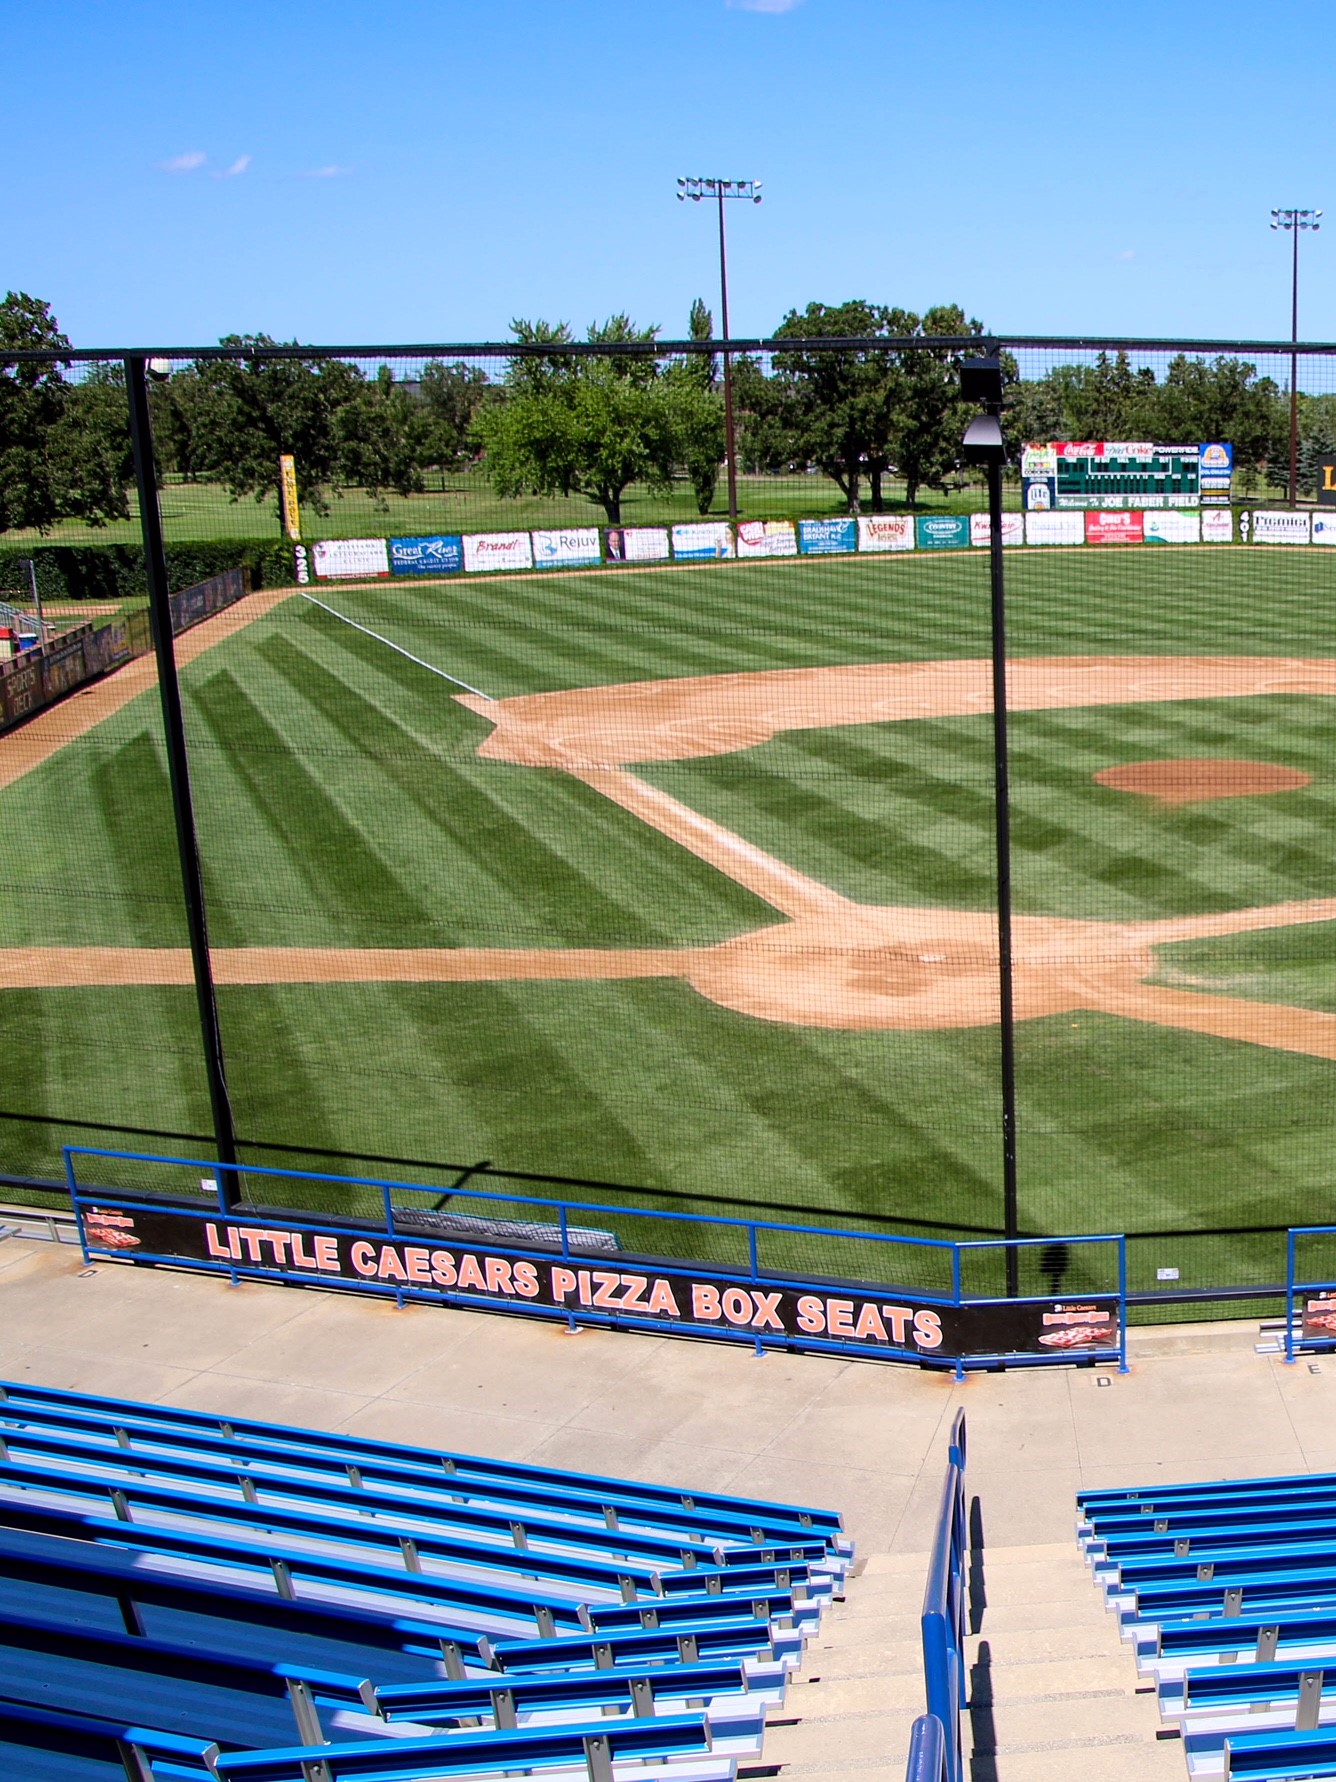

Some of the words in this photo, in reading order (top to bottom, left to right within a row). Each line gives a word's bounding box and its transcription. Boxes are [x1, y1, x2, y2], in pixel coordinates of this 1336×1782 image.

[1101, 497, 1123, 508] JOE
[1128, 497, 1163, 508] FABER
[1168, 497, 1199, 508] FIELD
[866, 522, 906, 537] LEGENDS
[1239, 511, 1250, 542] 401
[392, 544, 423, 560] Great
[294, 544, 310, 584] 325
[204, 1221, 341, 1273] LITTLE
[350, 1239, 540, 1298] CAESARS
[550, 1266, 682, 1317] PIZZA
[691, 1283, 787, 1331] BOX
[796, 1294, 944, 1349] SEATS
